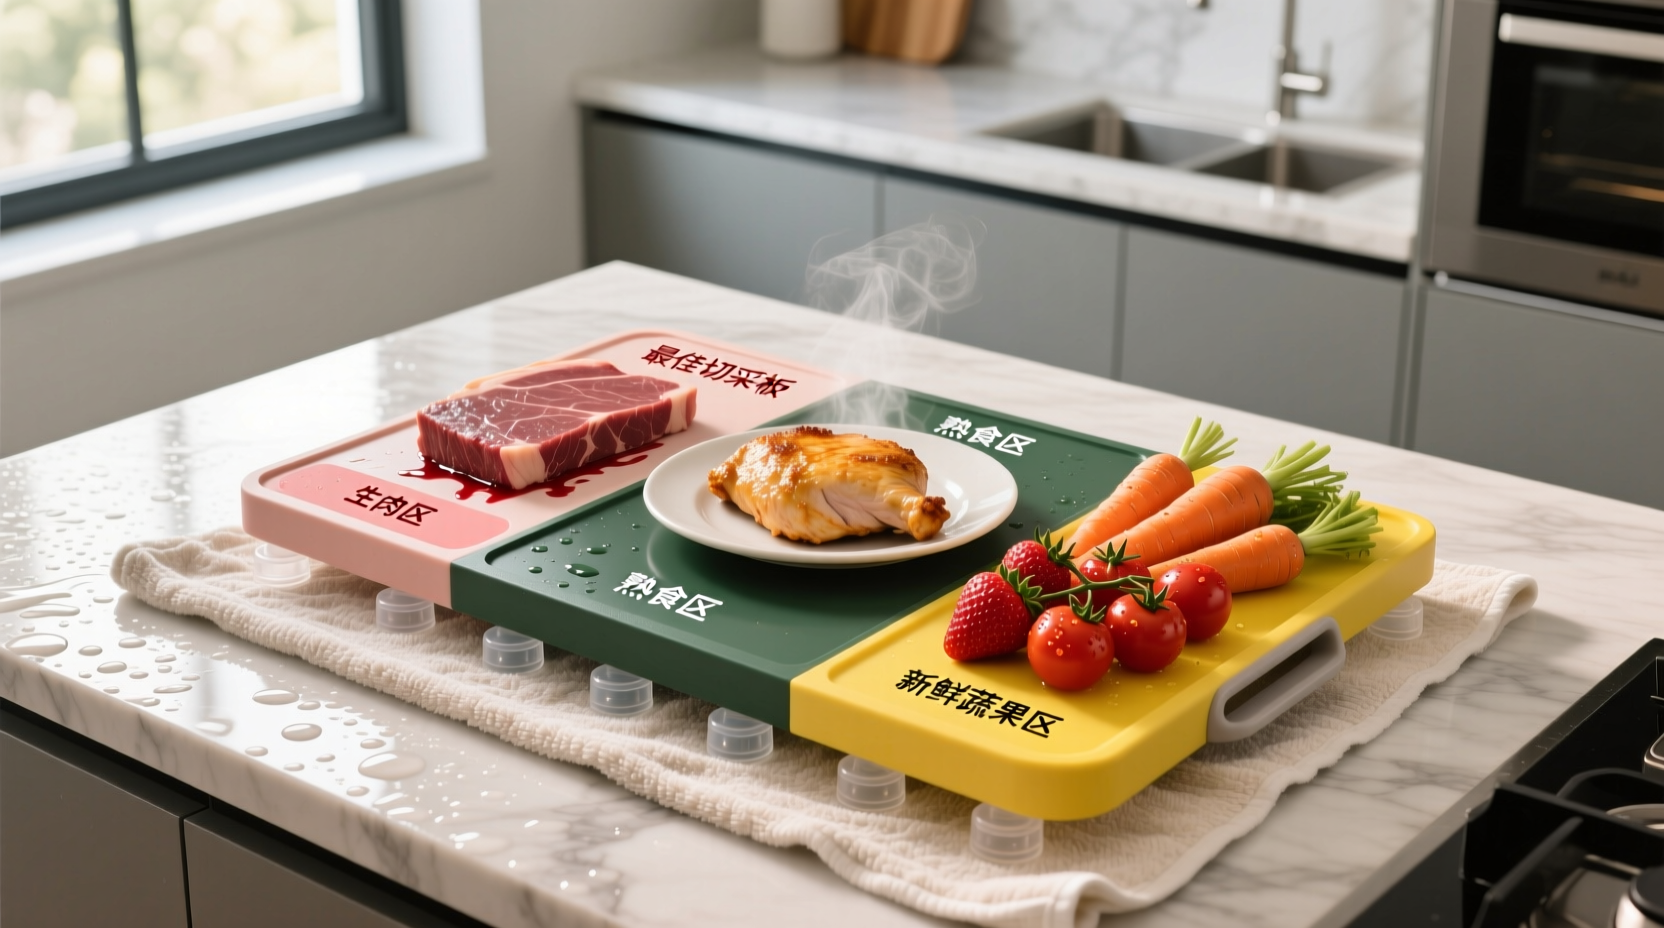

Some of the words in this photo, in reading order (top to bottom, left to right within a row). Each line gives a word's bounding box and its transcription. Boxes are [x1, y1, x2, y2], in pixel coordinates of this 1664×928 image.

[933, 415, 1037, 456] 熟食区
[343, 485, 438, 527] 生肉区
[613, 571, 724, 622] 熟食区
[895, 669, 1065, 738] 新鲜蔬果区
